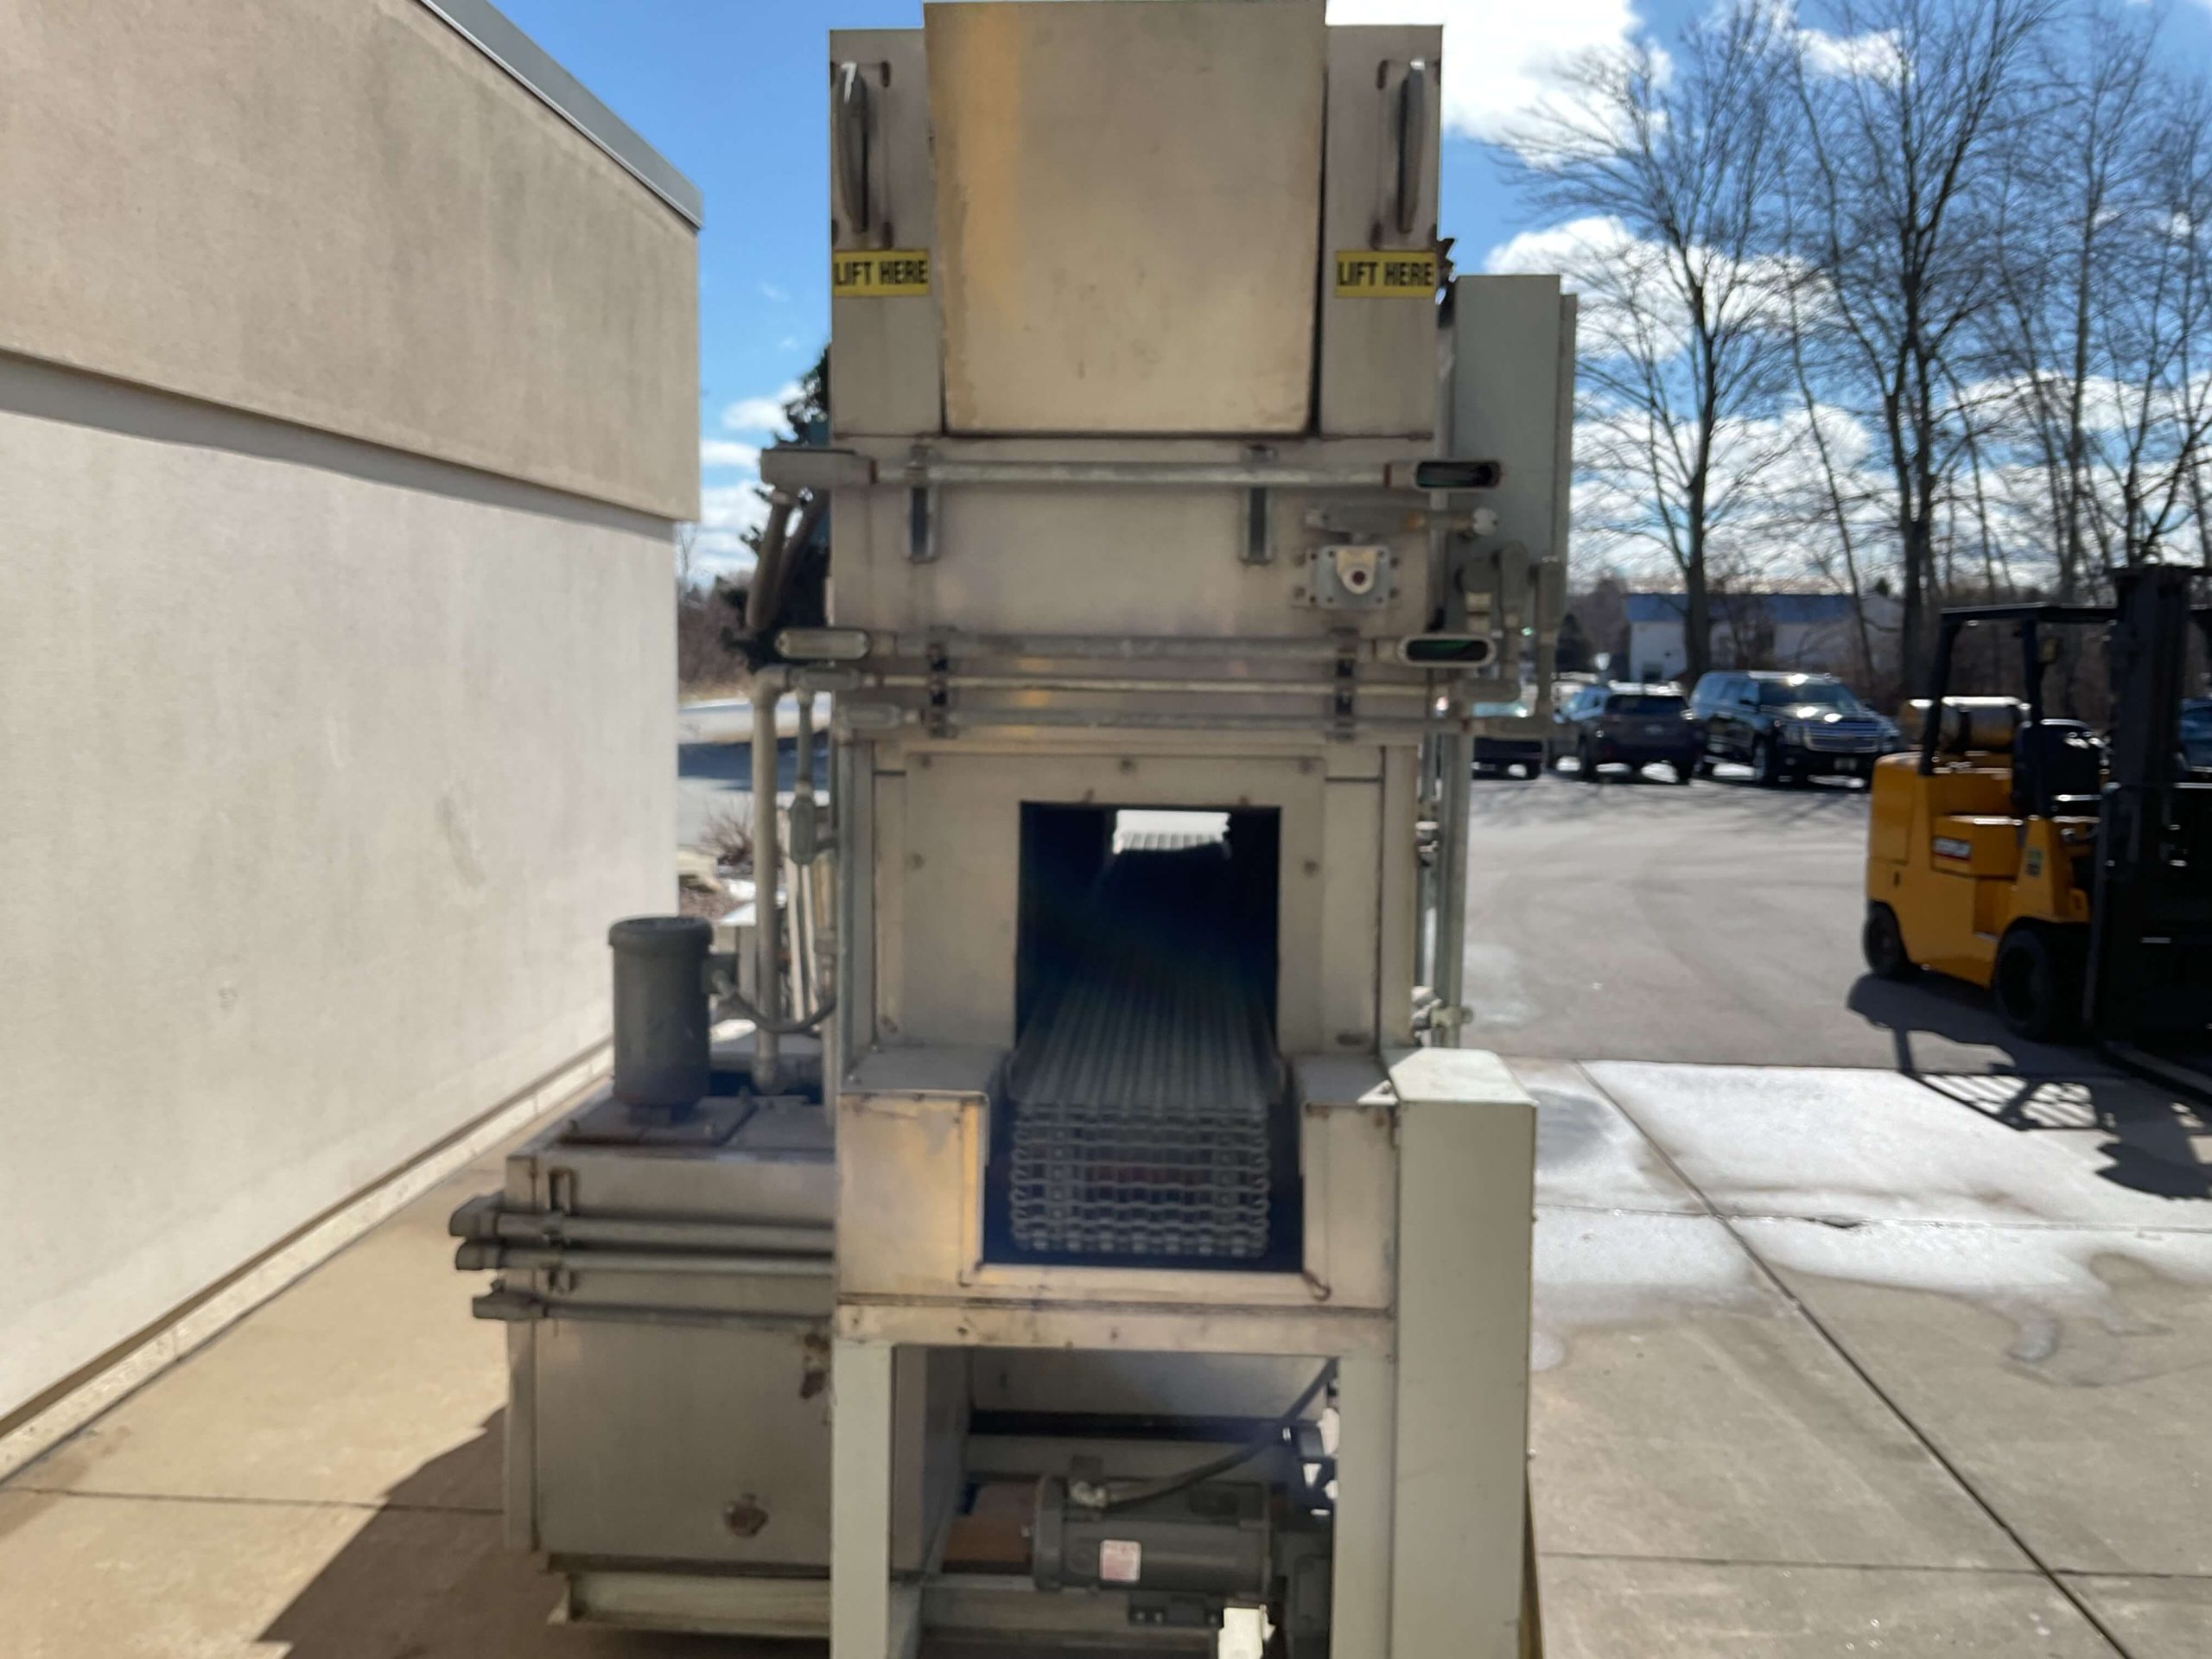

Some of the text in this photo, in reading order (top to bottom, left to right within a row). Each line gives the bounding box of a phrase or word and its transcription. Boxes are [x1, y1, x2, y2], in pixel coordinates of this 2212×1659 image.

[835, 260, 928, 285] LIFT HERE
[1338, 262, 1433, 286] LIFT HERE
